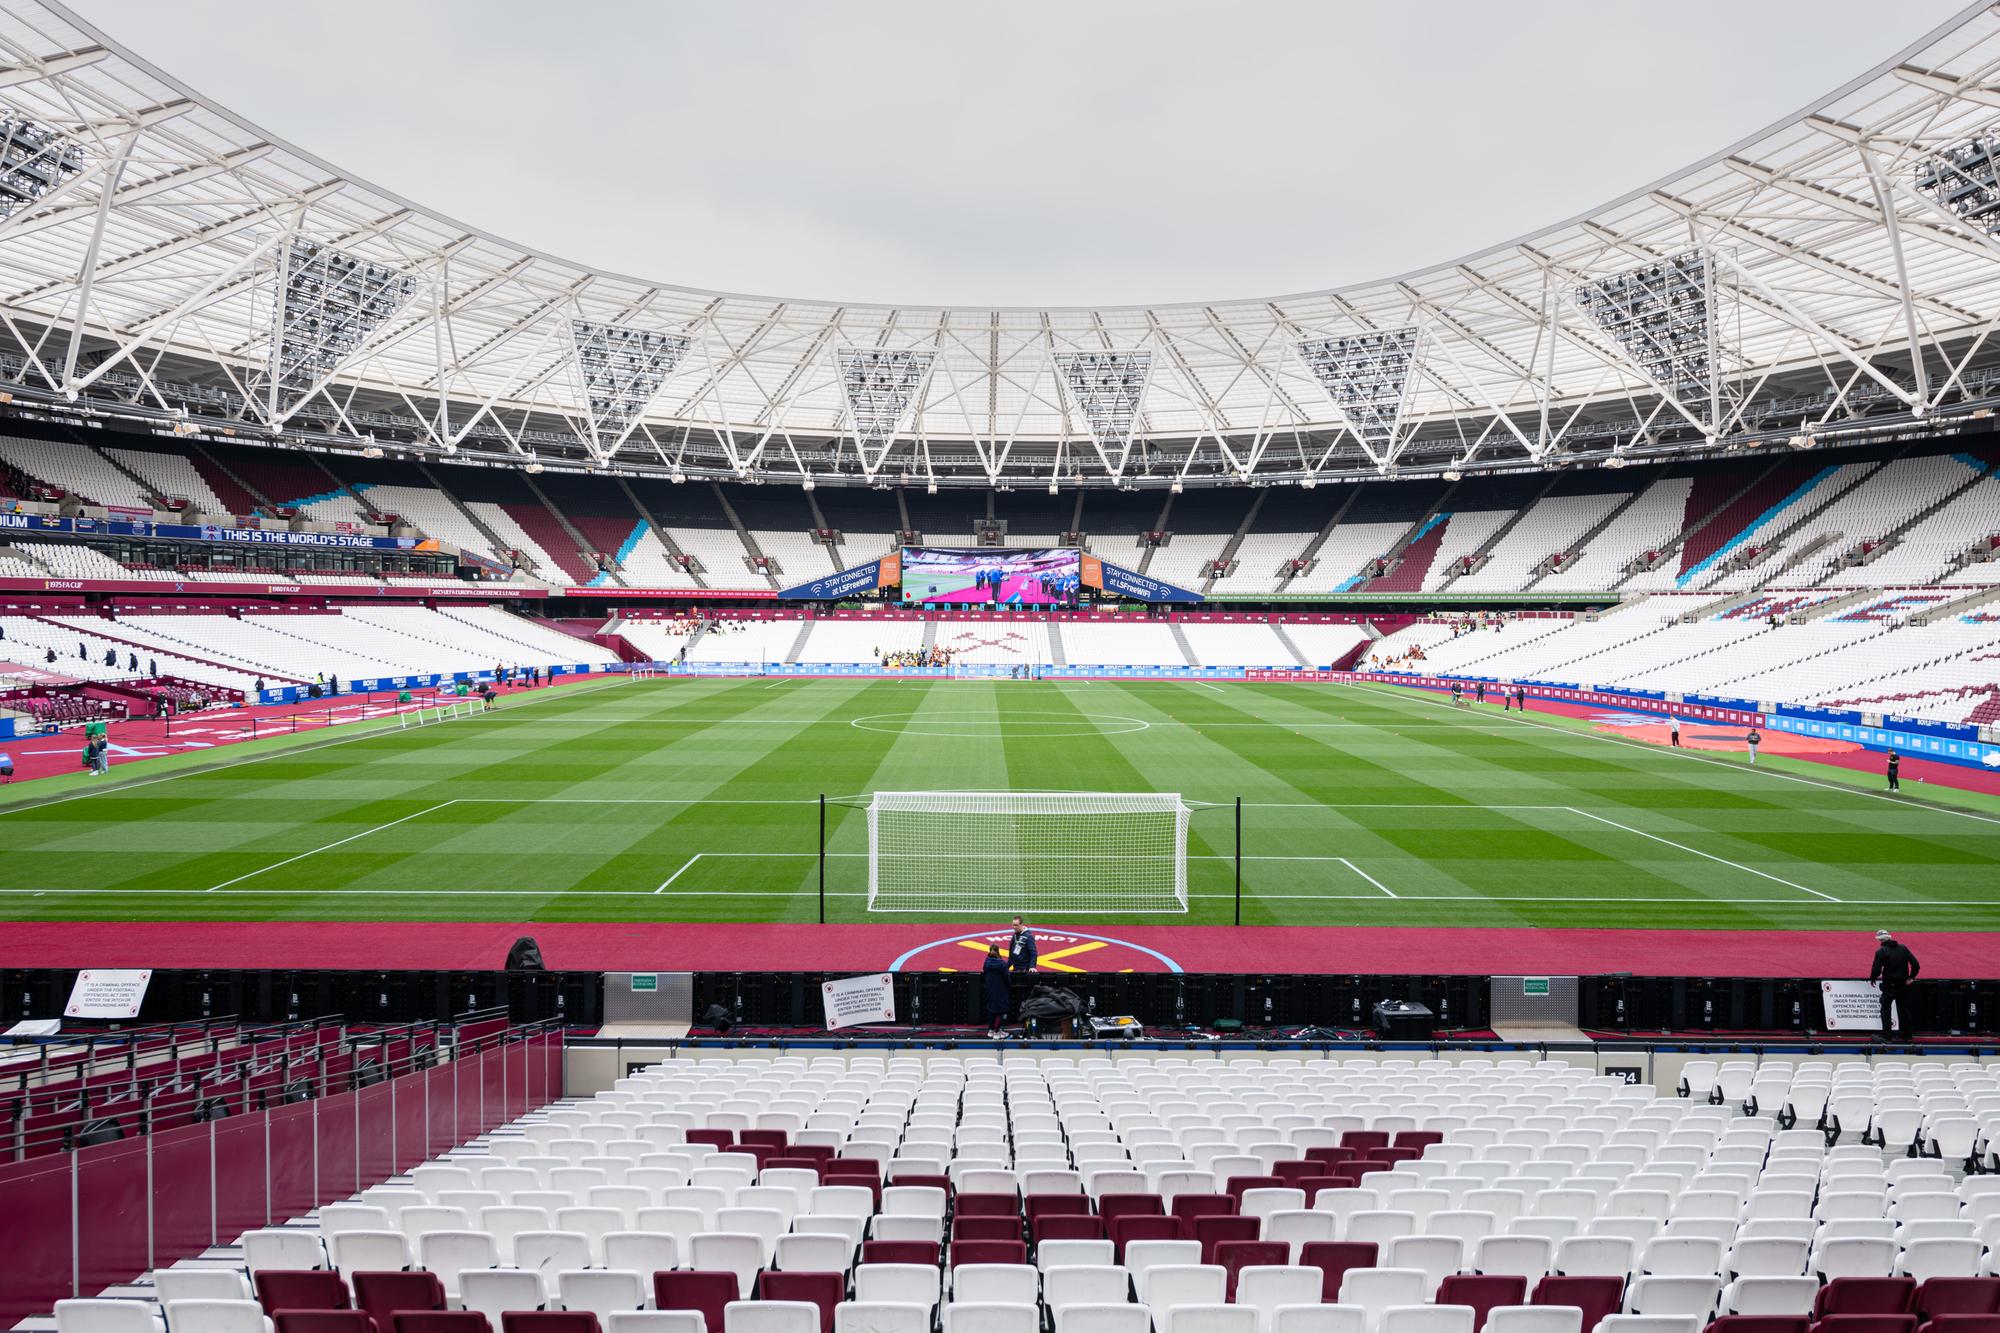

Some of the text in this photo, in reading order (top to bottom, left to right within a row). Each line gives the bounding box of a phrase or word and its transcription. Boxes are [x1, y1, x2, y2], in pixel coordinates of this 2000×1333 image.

[224, 530, 249, 542] THIS
[252, 532, 262, 542] IS
[264, 532, 286, 542] THE
[288, 533, 336, 546] WORLD'S
[338, 536, 373, 547] STAGE
[824, 577, 840, 588] STAY
[841, 565, 876, 583] CONNECTED
[1106, 567, 1121, 577] STAY
[1122, 572, 1158, 591] CONNECTED
[269, 689, 283, 697] BOYLE
